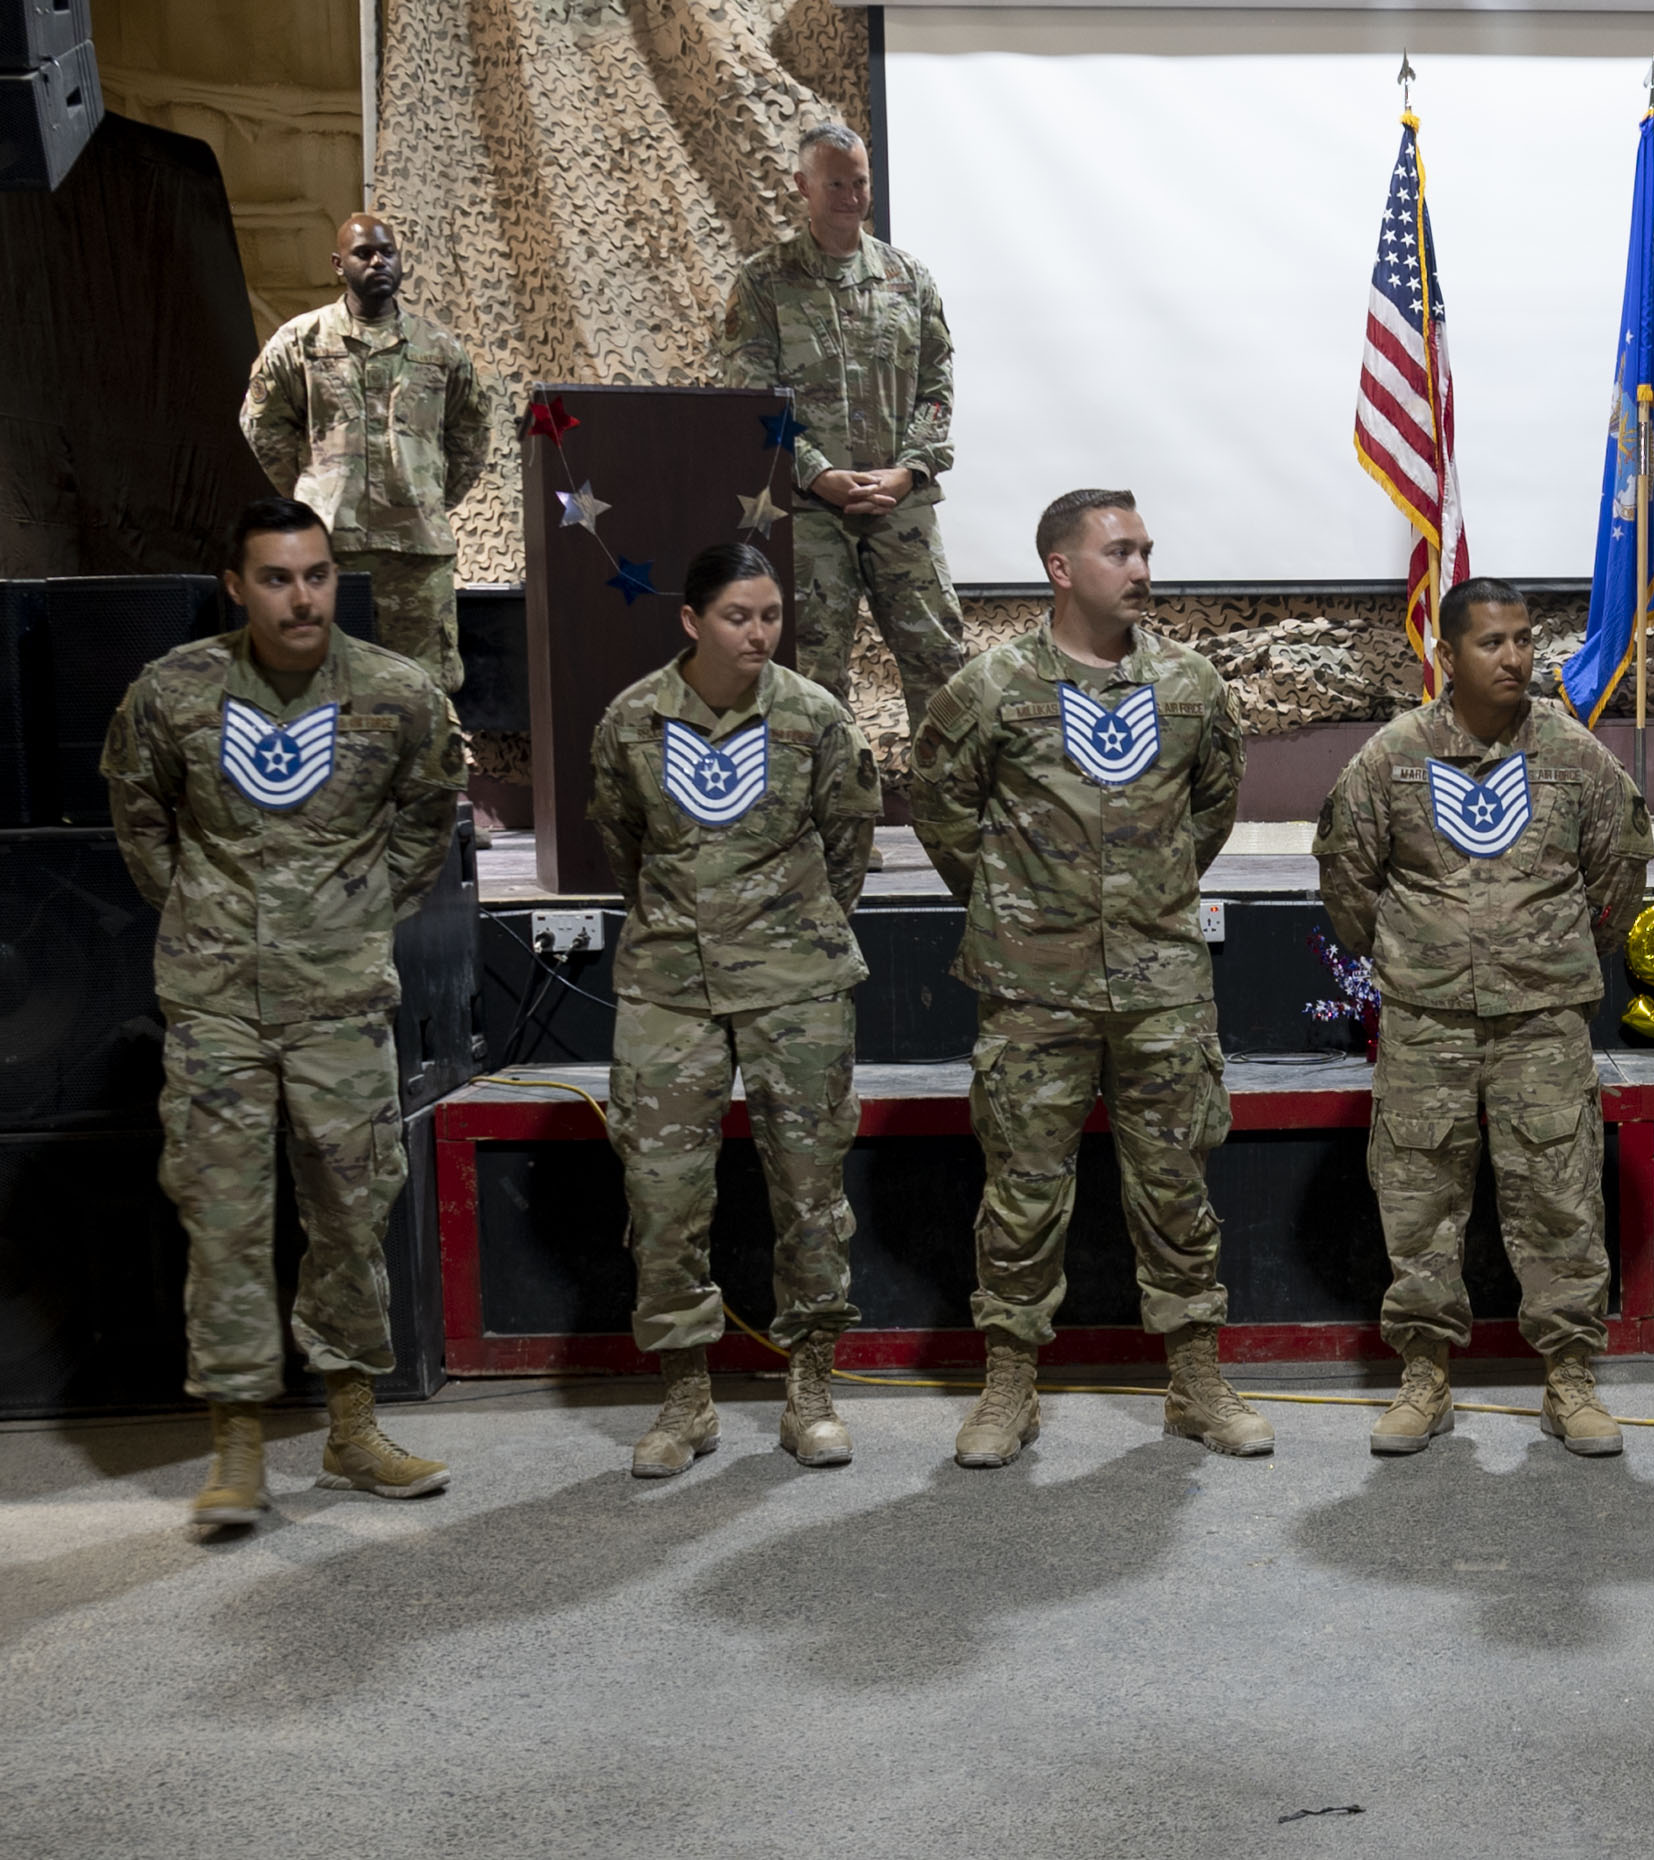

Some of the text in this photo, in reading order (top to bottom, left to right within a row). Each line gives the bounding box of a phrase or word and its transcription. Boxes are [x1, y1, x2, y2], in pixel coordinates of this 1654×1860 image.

[1165, 703, 1178, 713] AIR
[1180, 703, 1204, 713] FORCE
[1400, 768, 1427, 780] MARC
[1538, 769, 1553, 780] AIR
[1555, 769, 1581, 780] FORCE
